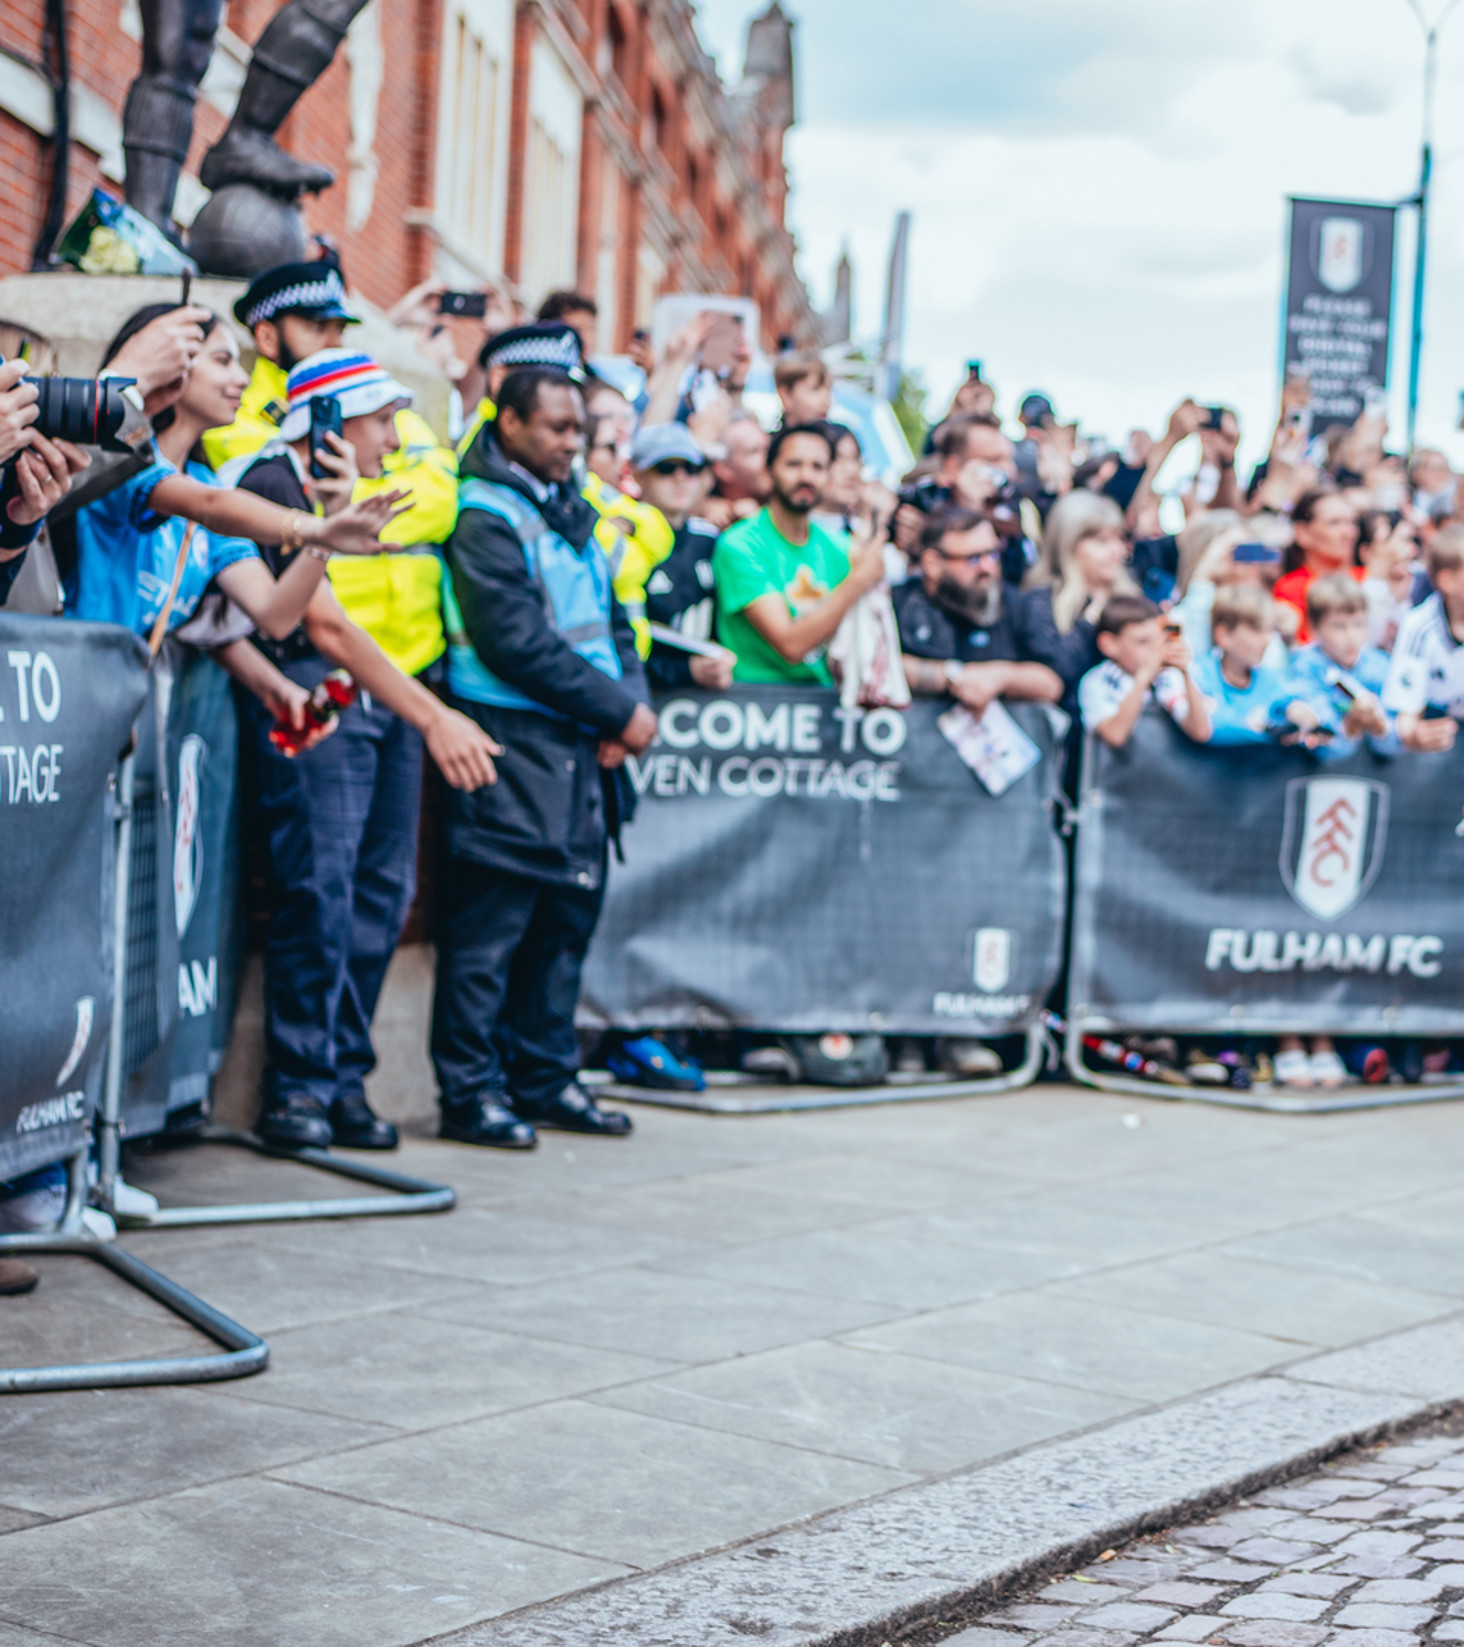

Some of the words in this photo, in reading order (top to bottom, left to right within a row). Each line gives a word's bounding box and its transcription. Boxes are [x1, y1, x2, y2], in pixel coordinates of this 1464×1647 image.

[7, 650, 62, 723] TO
[651, 698, 823, 754] COME
[832, 701, 908, 757] TO
[717, 755, 902, 803] COTTAGE
[1204, 928, 1387, 975] FULHAM
[1386, 934, 1446, 980] FC
